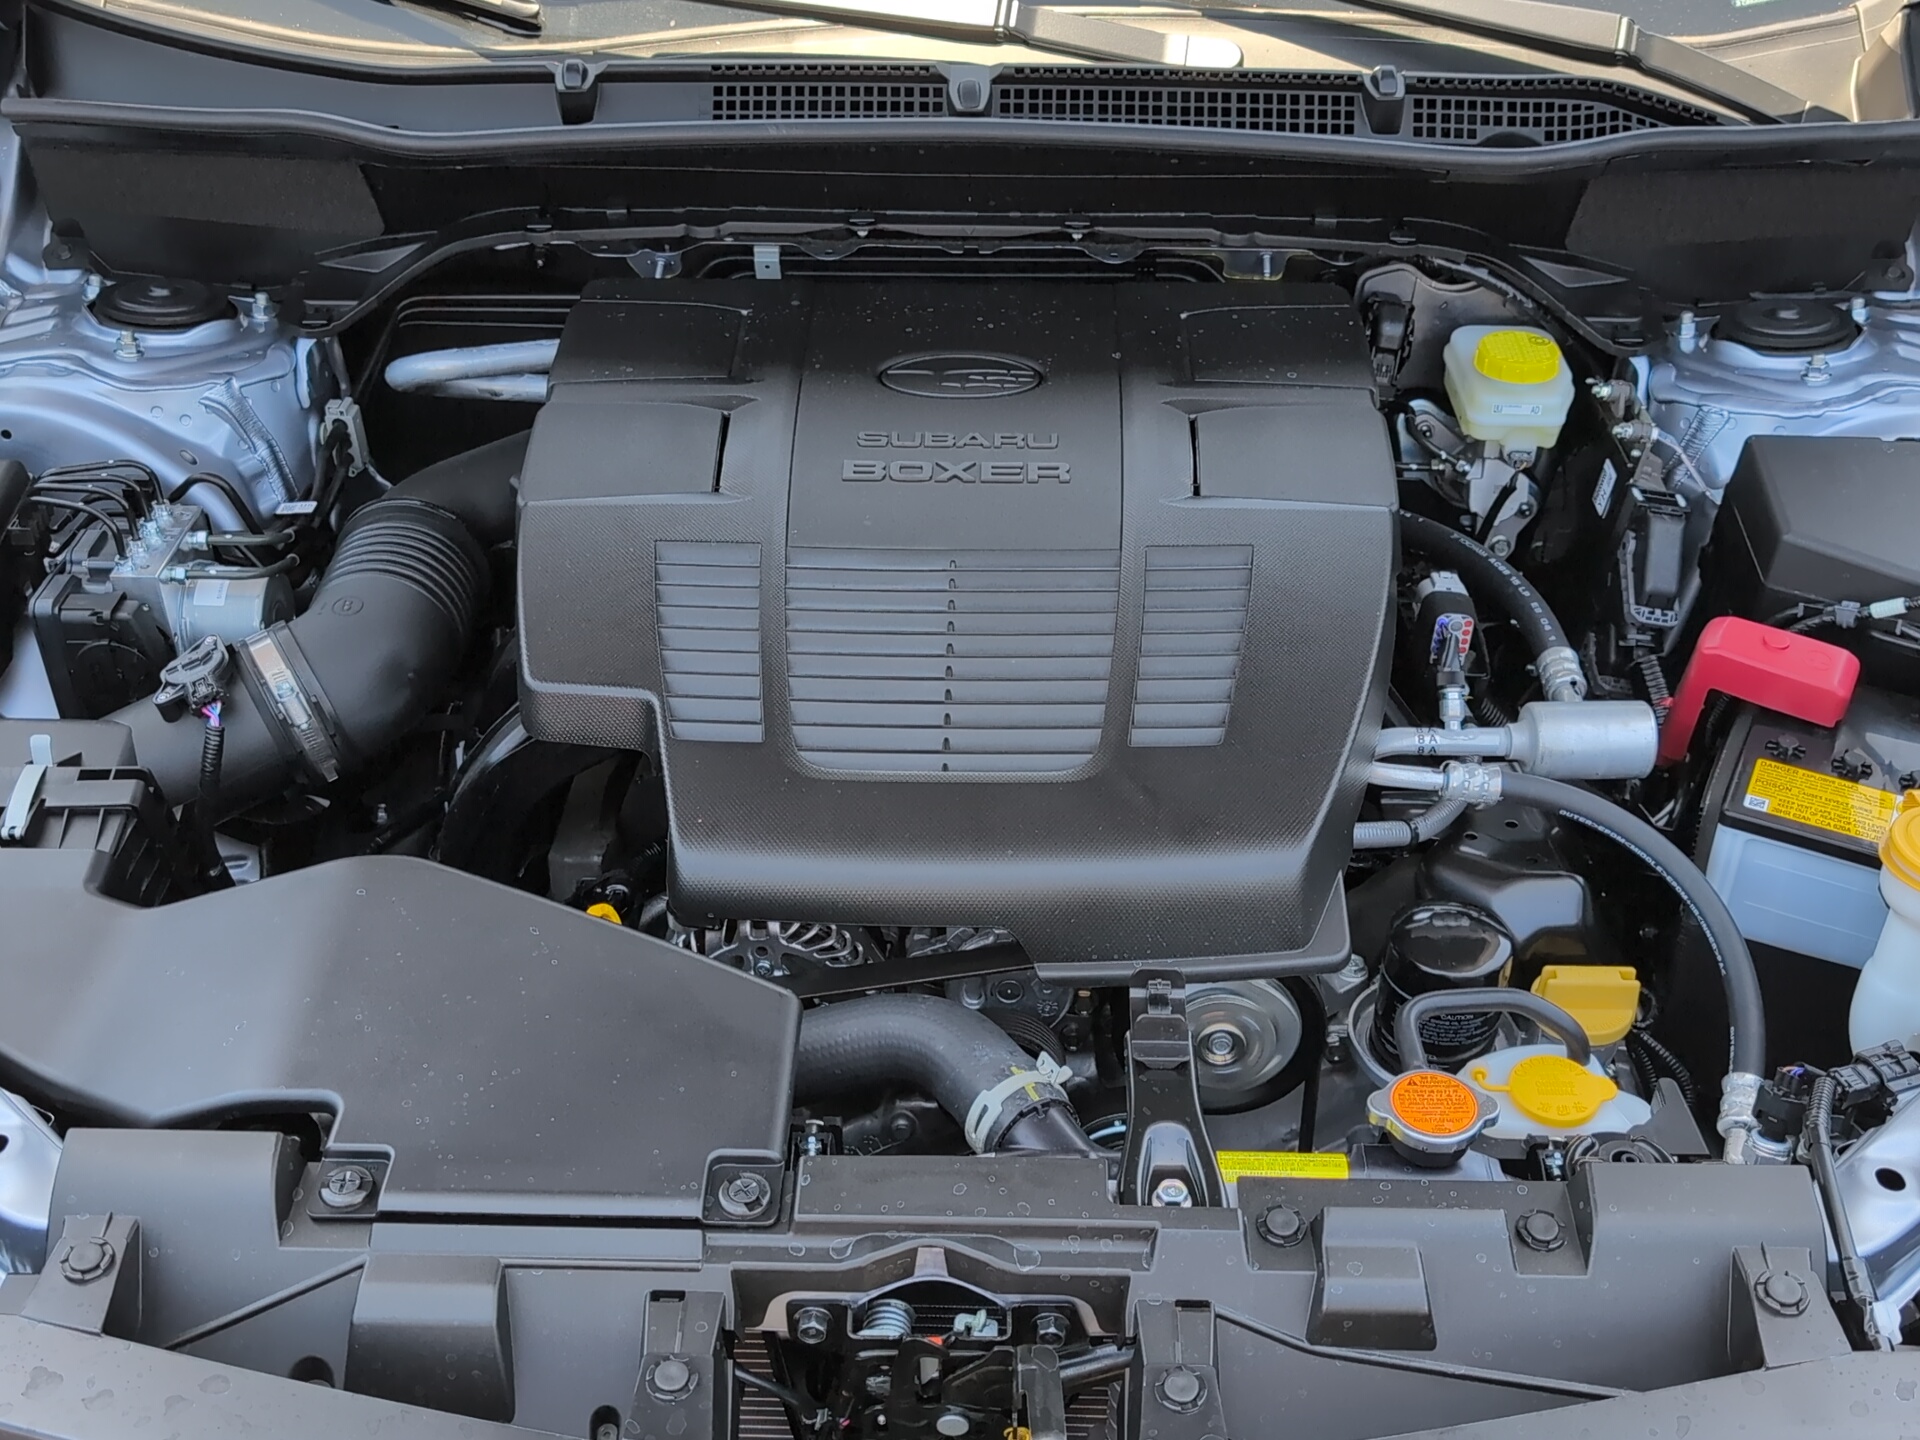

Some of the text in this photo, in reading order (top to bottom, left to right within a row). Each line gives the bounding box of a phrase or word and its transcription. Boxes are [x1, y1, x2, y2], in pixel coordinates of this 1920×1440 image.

[857, 431, 1059, 450] SUBARU
[841, 459, 1072, 484] BOXER
[1760, 760, 1800, 776] DANGER
[1754, 778, 1793, 792] POISON
[1797, 790, 1823, 801] CAUSES
[1813, 818, 1833, 829] CCA
[1440, 1013, 1475, 1021] CAUTION
